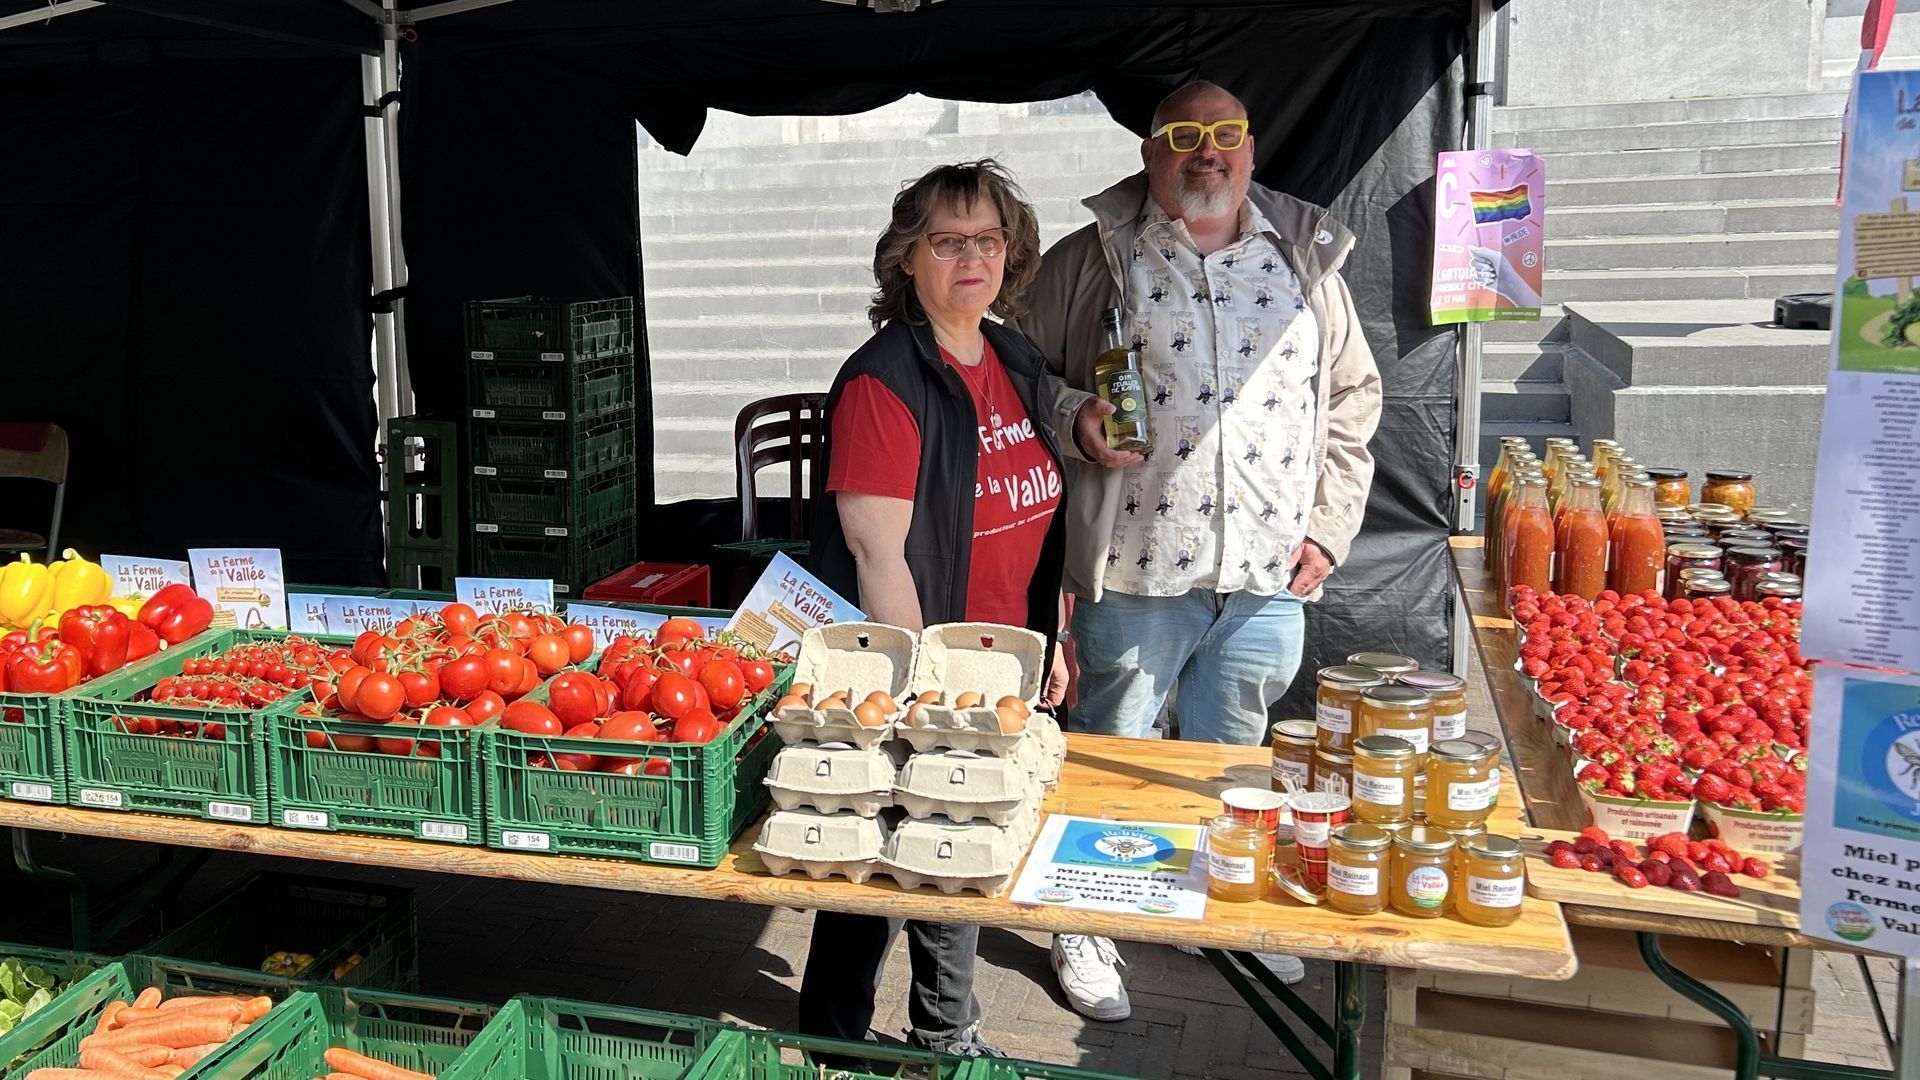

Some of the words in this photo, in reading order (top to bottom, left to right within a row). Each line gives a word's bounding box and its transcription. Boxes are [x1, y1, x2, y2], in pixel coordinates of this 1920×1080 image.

[974, 483, 984, 498] e
[987, 476, 1001, 495] la
[1004, 460, 1062, 512] Vallé
[973, 522, 1016, 538] producteur
[207, 557, 220, 568] La
[222, 555, 255, 567] Ferme
[118, 564, 130, 576] La
[132, 564, 164, 576] Ferme
[226, 565, 266, 583] Vallée
[473, 587, 486, 599] La
[489, 586, 523, 598] Ferme
[783, 570, 797, 587] La
[799, 581, 833, 609] Ferme
[306, 603, 319, 614] La
[342, 605, 355, 617] La
[358, 605, 392, 617] Ferme
[794, 592, 834, 626] Vallée
[585, 615, 598, 627] La
[602, 615, 637, 628] Ferme
[1368, 780, 1395, 791] Reinapi
[106, 794, 119, 803] 154
[306, 813, 319, 822] 154
[1607, 807, 1644, 818] Production
[1645, 811, 1678, 820] artisanale
[1629, 818, 1662, 828] raisonnée
[1733, 820, 1772, 832] Production
[527, 834, 540, 843] 154
[1756, 831, 1792, 841] raisonnée
[1843, 844, 1899, 866] Miel
[1220, 859, 1247, 869] Reinapi
[1056, 868, 1098, 876] Miel
[1103, 873, 1177, 884] produit
[1342, 870, 1370, 881] Reinapi
[1831, 866, 1890, 886] chez
[1044, 875, 1089, 884] chez
[1093, 880, 1142, 889] nous
[1166, 883, 1184, 892] la
[1475, 881, 1491, 891] Miel
[1053, 882, 1114, 894] Ferme
[1120, 888, 1144, 897] de
[1150, 891, 1169, 899] la
[1079, 892, 1138, 904] Vallée
[1846, 888, 1920, 914] Ferme
